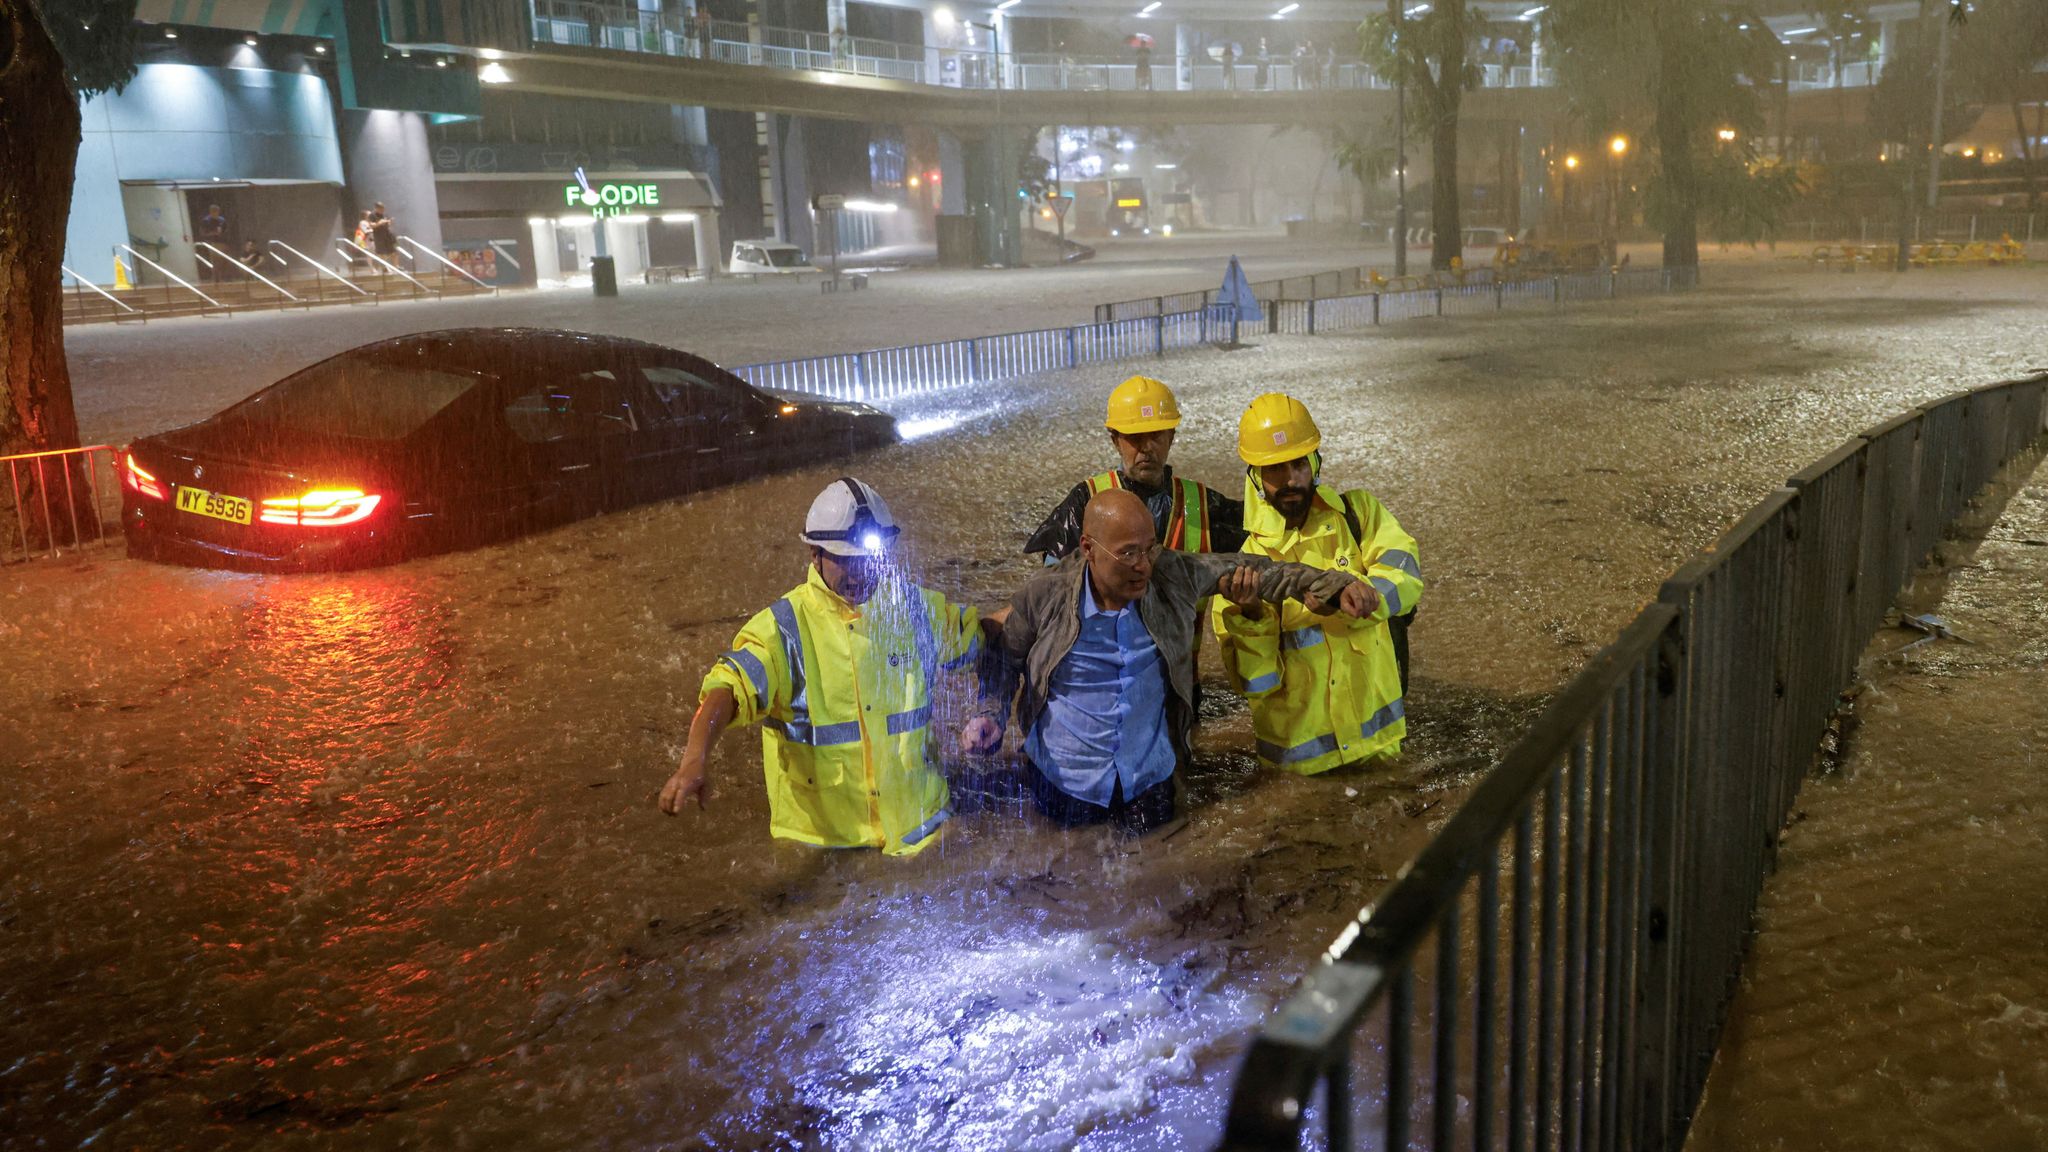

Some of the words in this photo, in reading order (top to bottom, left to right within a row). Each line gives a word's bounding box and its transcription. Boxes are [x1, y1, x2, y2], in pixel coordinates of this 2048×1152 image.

[565, 184, 659, 206] FOODIE
[182, 489, 202, 510] WY
[205, 495, 247, 520] 5936
